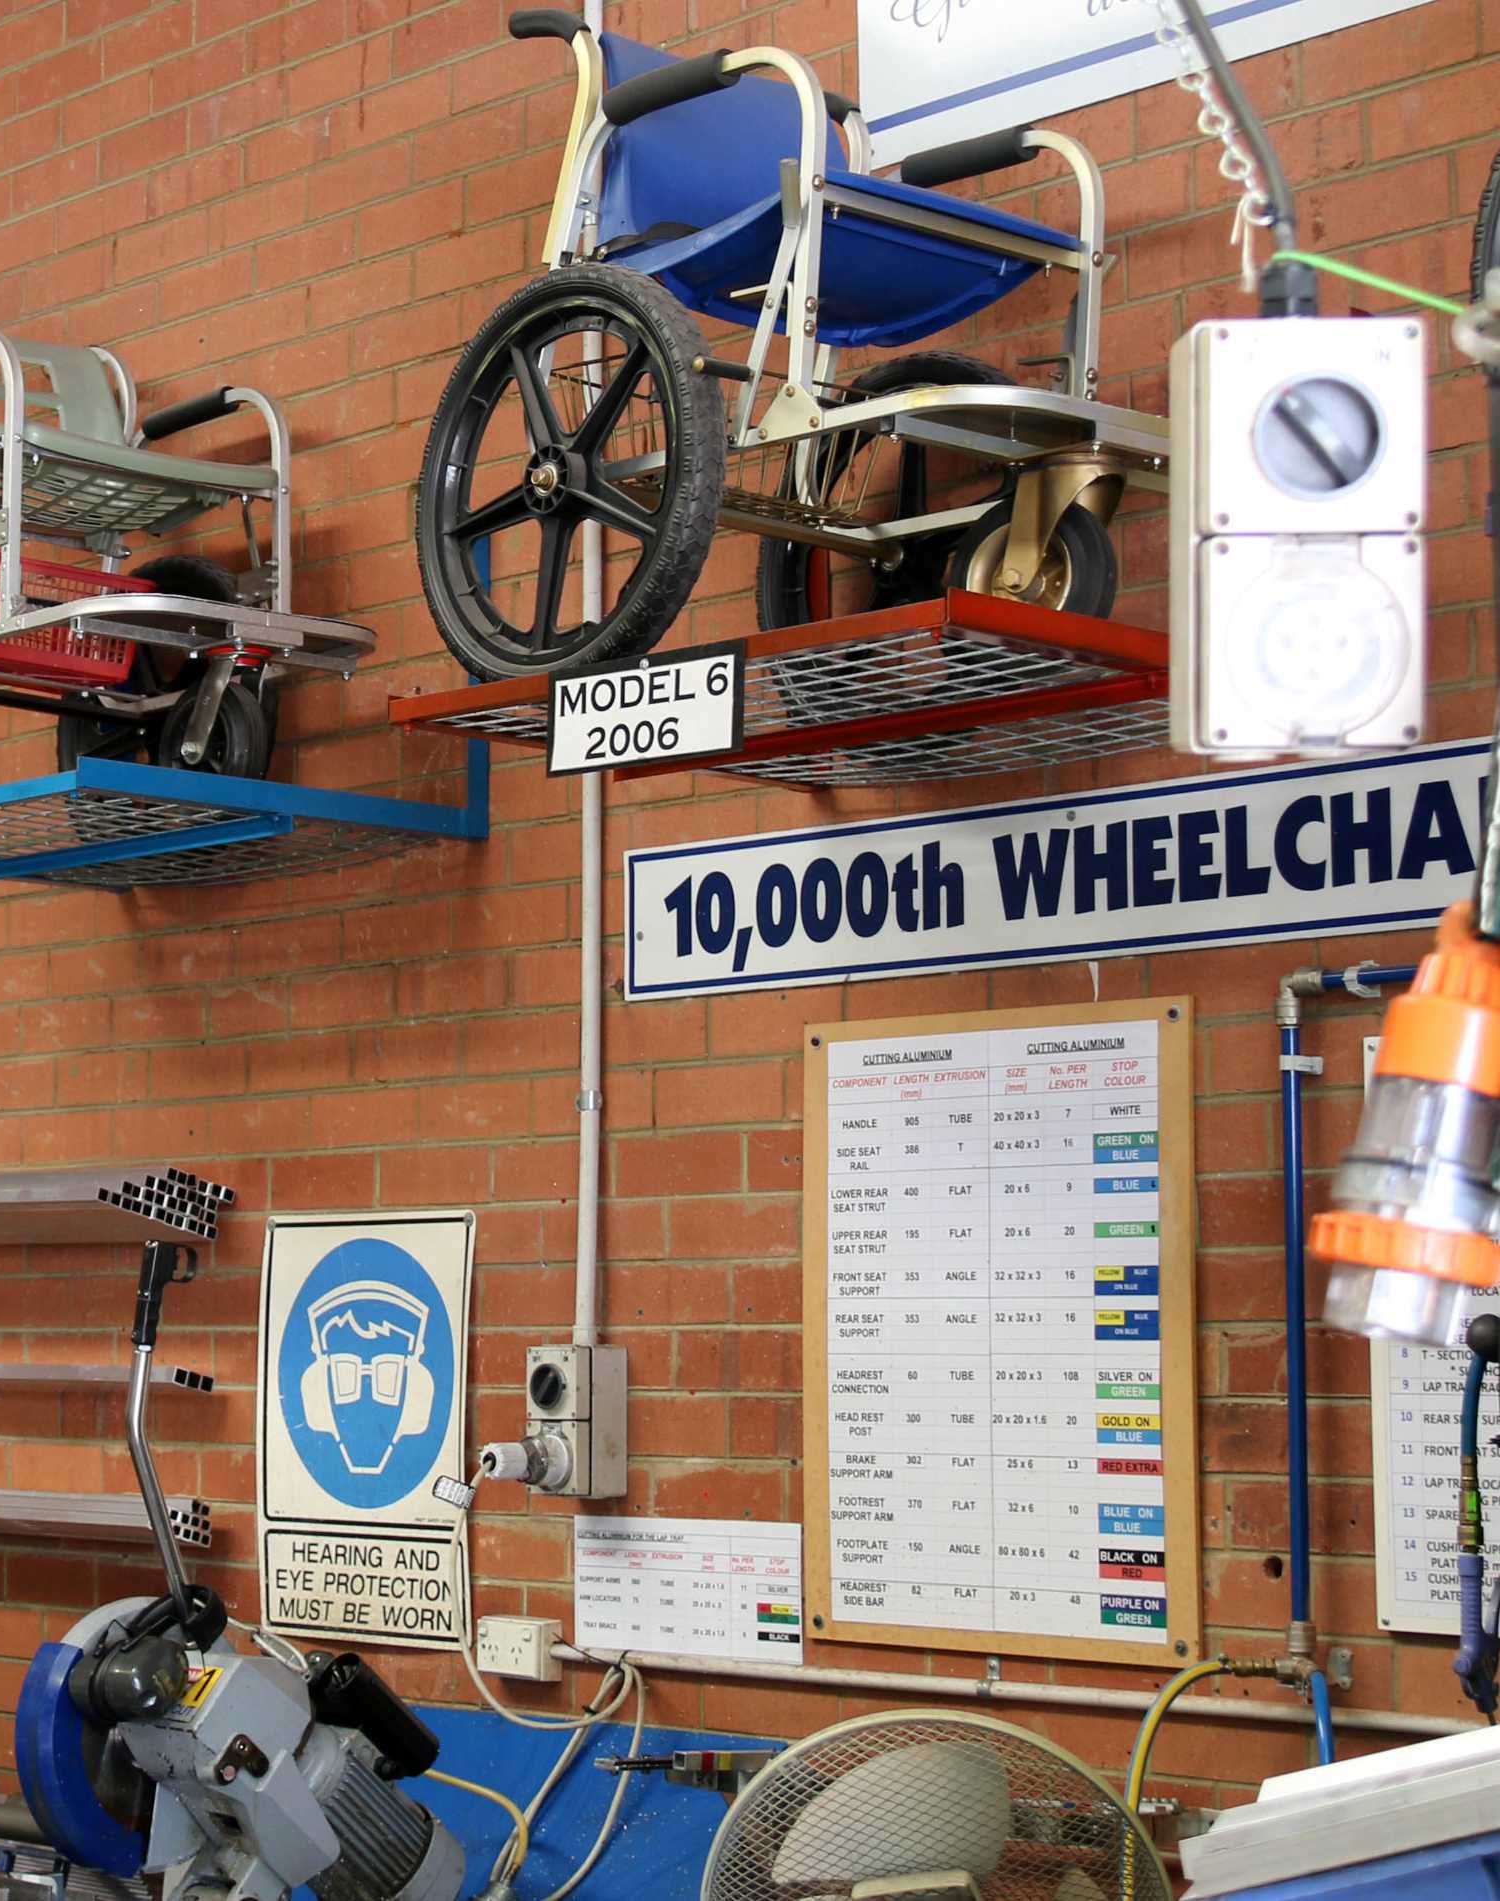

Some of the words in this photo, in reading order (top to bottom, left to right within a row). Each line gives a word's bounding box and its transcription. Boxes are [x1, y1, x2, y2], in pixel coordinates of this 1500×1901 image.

[560, 669, 695, 716] MODEL
[707, 662, 728, 696] 6
[585, 717, 679, 759] 2006
[664, 841, 965, 973] 10,000th
[1027, 1041, 1068, 1054] CUTTING
[1071, 1038, 1125, 1050] ALUMINIUM
[863, 1053, 900, 1065] CUTTING
[903, 1049, 952, 1062] ALUMINIUM
[1067, 1064, 1087, 1073] PER
[1112, 1061, 1138, 1072] STOP
[934, 1070, 986, 1082] EXTRUSION
[1006, 1068, 1027, 1077] SIZE
[833, 1077, 886, 1088] COMPONENT
[893, 1074, 929, 1085] LENGTH
[1049, 1079, 1088, 1089] LENGTH
[1104, 1076, 1146, 1086] COLOUR
[1110, 1105, 1140, 1116] WHITE
[843, 1119, 877, 1129] HANDLE
[905, 1116, 919, 1126] 905
[949, 1114, 972, 1124] TUBE
[1097, 1136, 1132, 1146] GREEN
[1139, 1134, 1154, 1144] ON
[837, 1149, 856, 1158] SIDE
[858, 1147, 881, 1157] SEAT
[1112, 1150, 1139, 1160] BLUE
[850, 1162, 870, 1170] RAIL
[949, 1185, 972, 1195] FLAT
[1113, 1180, 1140, 1190] BLUE
[831, 1189, 862, 1199] LOWER
[864, 1188, 888, 1197] REAR
[904, 1187, 919, 1196] 400
[833, 1204, 855, 1212] SEAT
[858, 1202, 886, 1212] STRUT
[832, 1231, 861, 1240] UPPER
[863, 1230, 887, 1239] REAR
[905, 1230, 919, 1238] 195
[1109, 1225, 1144, 1235] GREEN
[834, 1245, 855, 1254] SEAT
[858, 1245, 886, 1254] STRUT
[833, 1272, 861, 1281] FRONT
[864, 1272, 887, 1281] SEAT
[945, 1272, 976, 1280] ANGLE
[839, 1287, 880, 1296] SUPPORT
[1402, 1348, 1408, 1358] 8
[1422, 1350, 1427, 1360] T
[1437, 1350, 1476, 1360] SECTIO
[837, 1371, 883, 1379] HEADREST
[950, 1371, 974, 1380] TUBE
[1098, 1372, 1132, 1381] SILVER
[1138, 1372, 1152, 1381] ON
[832, 1384, 889, 1394] CONNECTION
[1403, 1380, 1408, 1389] 9
[1423, 1382, 1441, 1392] LAP
[1445, 1383, 1464, 1392] TRA
[1111, 1387, 1146, 1396] GREEN
[835, 1413, 859, 1422] HEAD
[861, 1413, 884, 1422] REST
[1103, 1416, 1130, 1426] GOLD
[1136, 1417, 1150, 1426] ON
[1401, 1412, 1412, 1421] 10
[1424, 1414, 1450, 1424] REAR
[849, 1427, 872, 1436] POST
[1116, 1432, 1142, 1442] BLUE
[1401, 1445, 1412, 1454] 11
[1424, 1447, 1458, 1456] FRONT
[846, 1455, 876, 1464] BRAKE
[906, 1456, 922, 1464] 302
[952, 1458, 975, 1467] FLAT
[1102, 1461, 1122, 1472] RED
[1125, 1463, 1158, 1473] EXTRA
[830, 1469, 870, 1478] SUPPORT
[873, 1470, 893, 1479] ARM
[1402, 1476, 1413, 1486] 12
[1425, 1478, 1445, 1487] LAP
[839, 1497, 885, 1507] FOOTREST
[908, 1499, 922, 1508] 370
[831, 1511, 871, 1520] SUPPORT
[875, 1512, 894, 1521] ARM
[1104, 1507, 1130, 1517] BLUE
[1138, 1508, 1153, 1518] ON
[1403, 1508, 1415, 1518] 13
[1426, 1510, 1459, 1520] SPARE
[1114, 1522, 1140, 1532] BLUE
[837, 1539, 888, 1550] FOOTPLATE
[909, 1542, 923, 1551] 150
[950, 1544, 980, 1554] ANGLE
[1405, 1540, 1416, 1550] 14
[1427, 1542, 1464, 1552] CUSHI
[292, 1542, 383, 1568] HEARING
[395, 1549, 440, 1571] AND
[843, 1553, 883, 1564] SUPPORT
[1100, 1552, 1134, 1562] BLACK
[1142, 1553, 1157, 1564] ON
[1431, 1558, 1459, 1568] PLAT
[1122, 1568, 1142, 1578] RED
[1405, 1572, 1417, 1581] 15
[1428, 1573, 1459, 1584] CUSHI
[276, 1569, 314, 1591] EYE
[840, 1582, 886, 1593] HEADREST
[954, 1588, 977, 1598] FLAT
[844, 1596, 863, 1605] SIDE
[866, 1597, 884, 1606] BAR
[1102, 1597, 1142, 1609] PURPLE
[1144, 1600, 1159, 1610] ON
[279, 1597, 333, 1621] MUST
[343, 1603, 370, 1624] BE
[383, 1605, 452, 1631] WORN
[1116, 1614, 1151, 1624] GREEN
